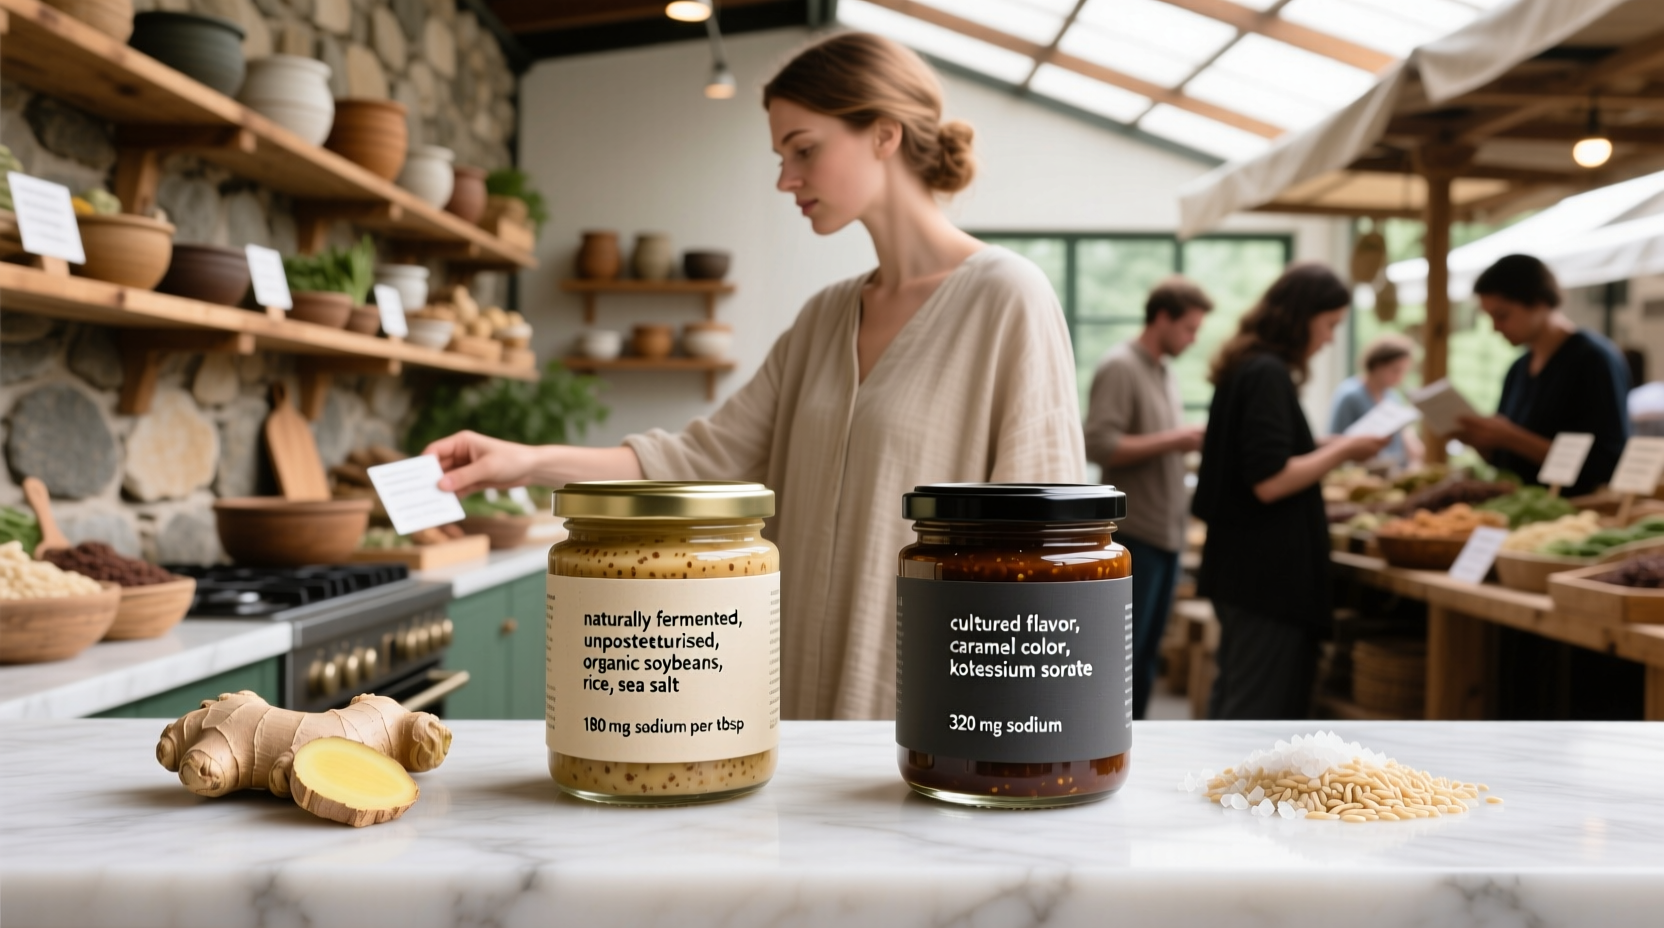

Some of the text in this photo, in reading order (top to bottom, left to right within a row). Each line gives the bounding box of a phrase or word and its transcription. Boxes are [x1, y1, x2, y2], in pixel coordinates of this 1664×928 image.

[584, 609, 743, 633] naturally fermented,
[949, 613, 1080, 634] cultured flavor,
[949, 636, 1071, 658] caramel color,
[582, 653, 723, 675] organic soybeans,
[949, 658, 1036, 678] kotessium
[583, 674, 680, 696] rice, sea salt
[583, 716, 607, 733] 180
[608, 722, 631, 738] mg
[690, 722, 713, 737] per
[716, 715, 745, 735] tbsp
[949, 713, 1063, 738] 320 mg sodium
